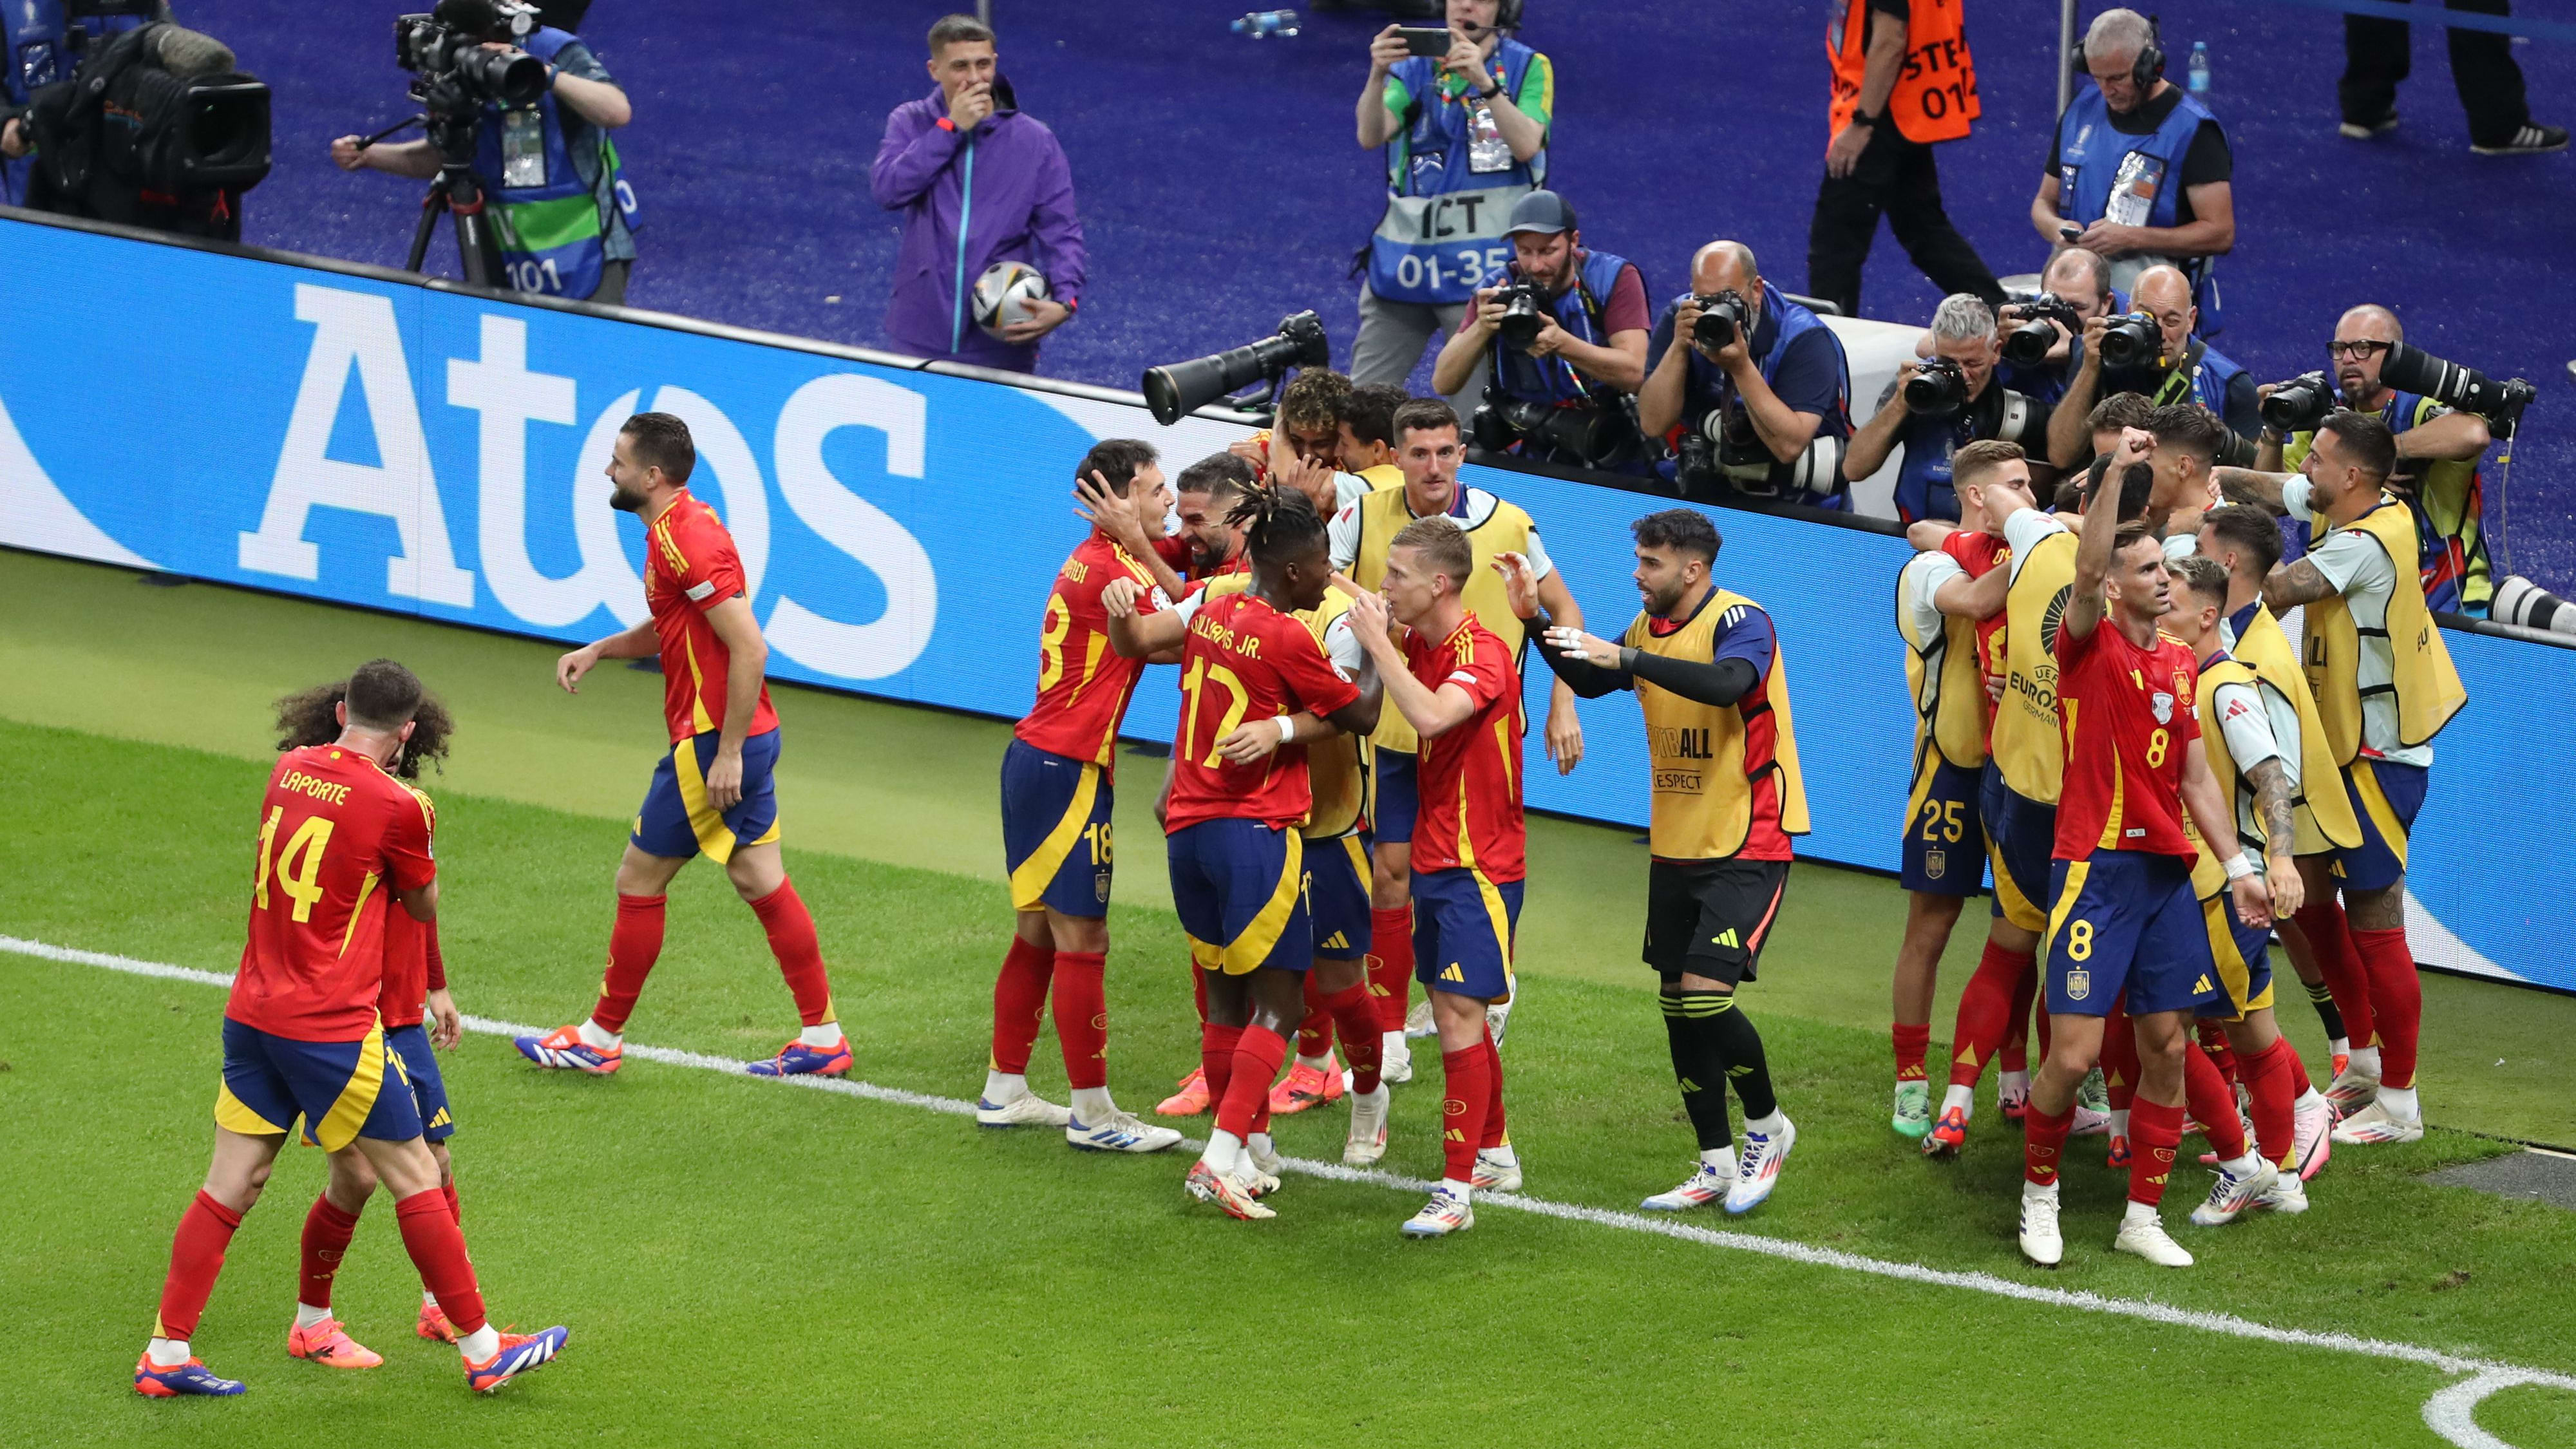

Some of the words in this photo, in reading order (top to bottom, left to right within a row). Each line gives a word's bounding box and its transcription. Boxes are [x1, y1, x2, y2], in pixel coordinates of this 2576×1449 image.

[1421, 195, 1485, 239] ICT
[505, 258, 562, 293] 101
[1397, 247, 1509, 288] 01-35
[237, 282, 938, 680] Atos
[1235, 634, 1262, 660] JR.
[2034, 668, 2059, 683] UEF
[1182, 655, 1249, 770] 17
[2145, 727, 2170, 769] 8
[278, 768, 352, 806] LAPORTE
[1922, 798, 1965, 843] 25
[255, 804, 336, 924] 14
[1083, 822, 1113, 865] 18
[2067, 918, 2094, 961] 8
